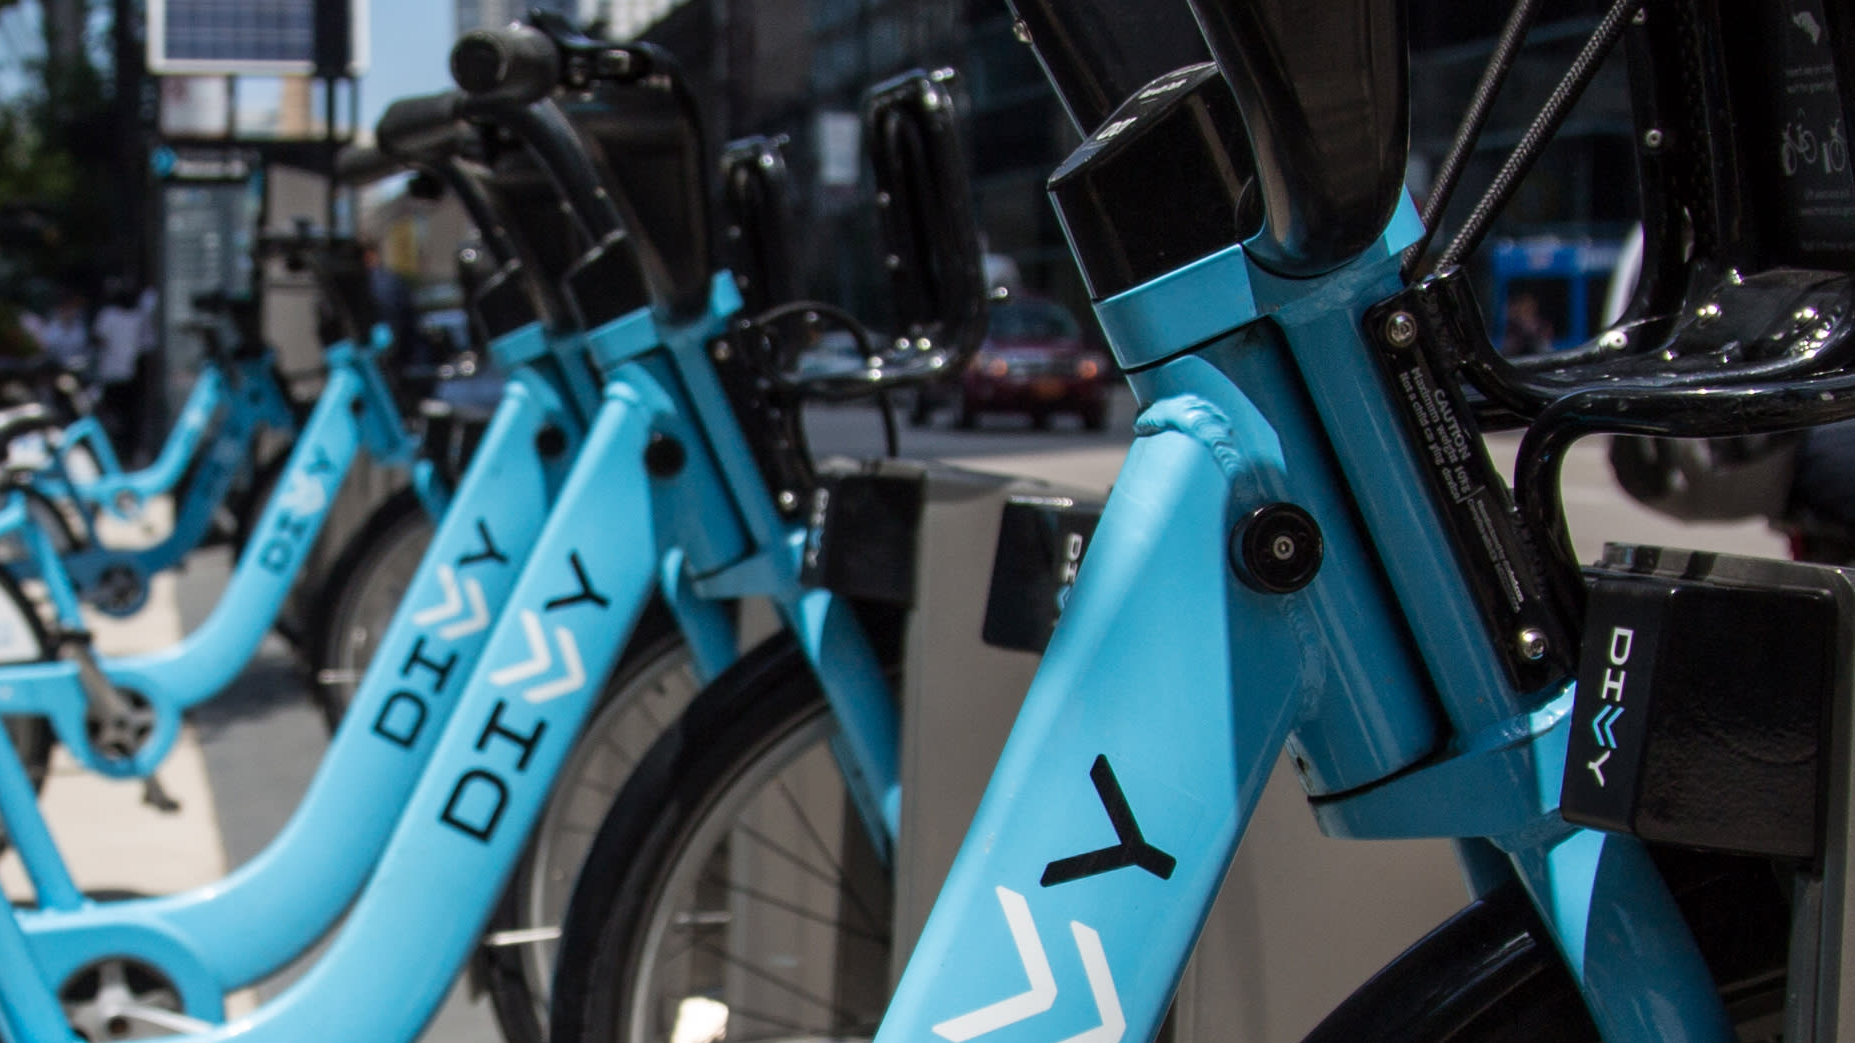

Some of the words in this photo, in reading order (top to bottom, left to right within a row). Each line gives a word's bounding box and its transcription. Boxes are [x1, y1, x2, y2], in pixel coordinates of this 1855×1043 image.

[1434, 388, 1471, 461] CAUTION
[371, 517, 510, 751] DIVVY
[439, 551, 611, 845] DIVVY
[1586, 627, 1634, 788] DIVVY
